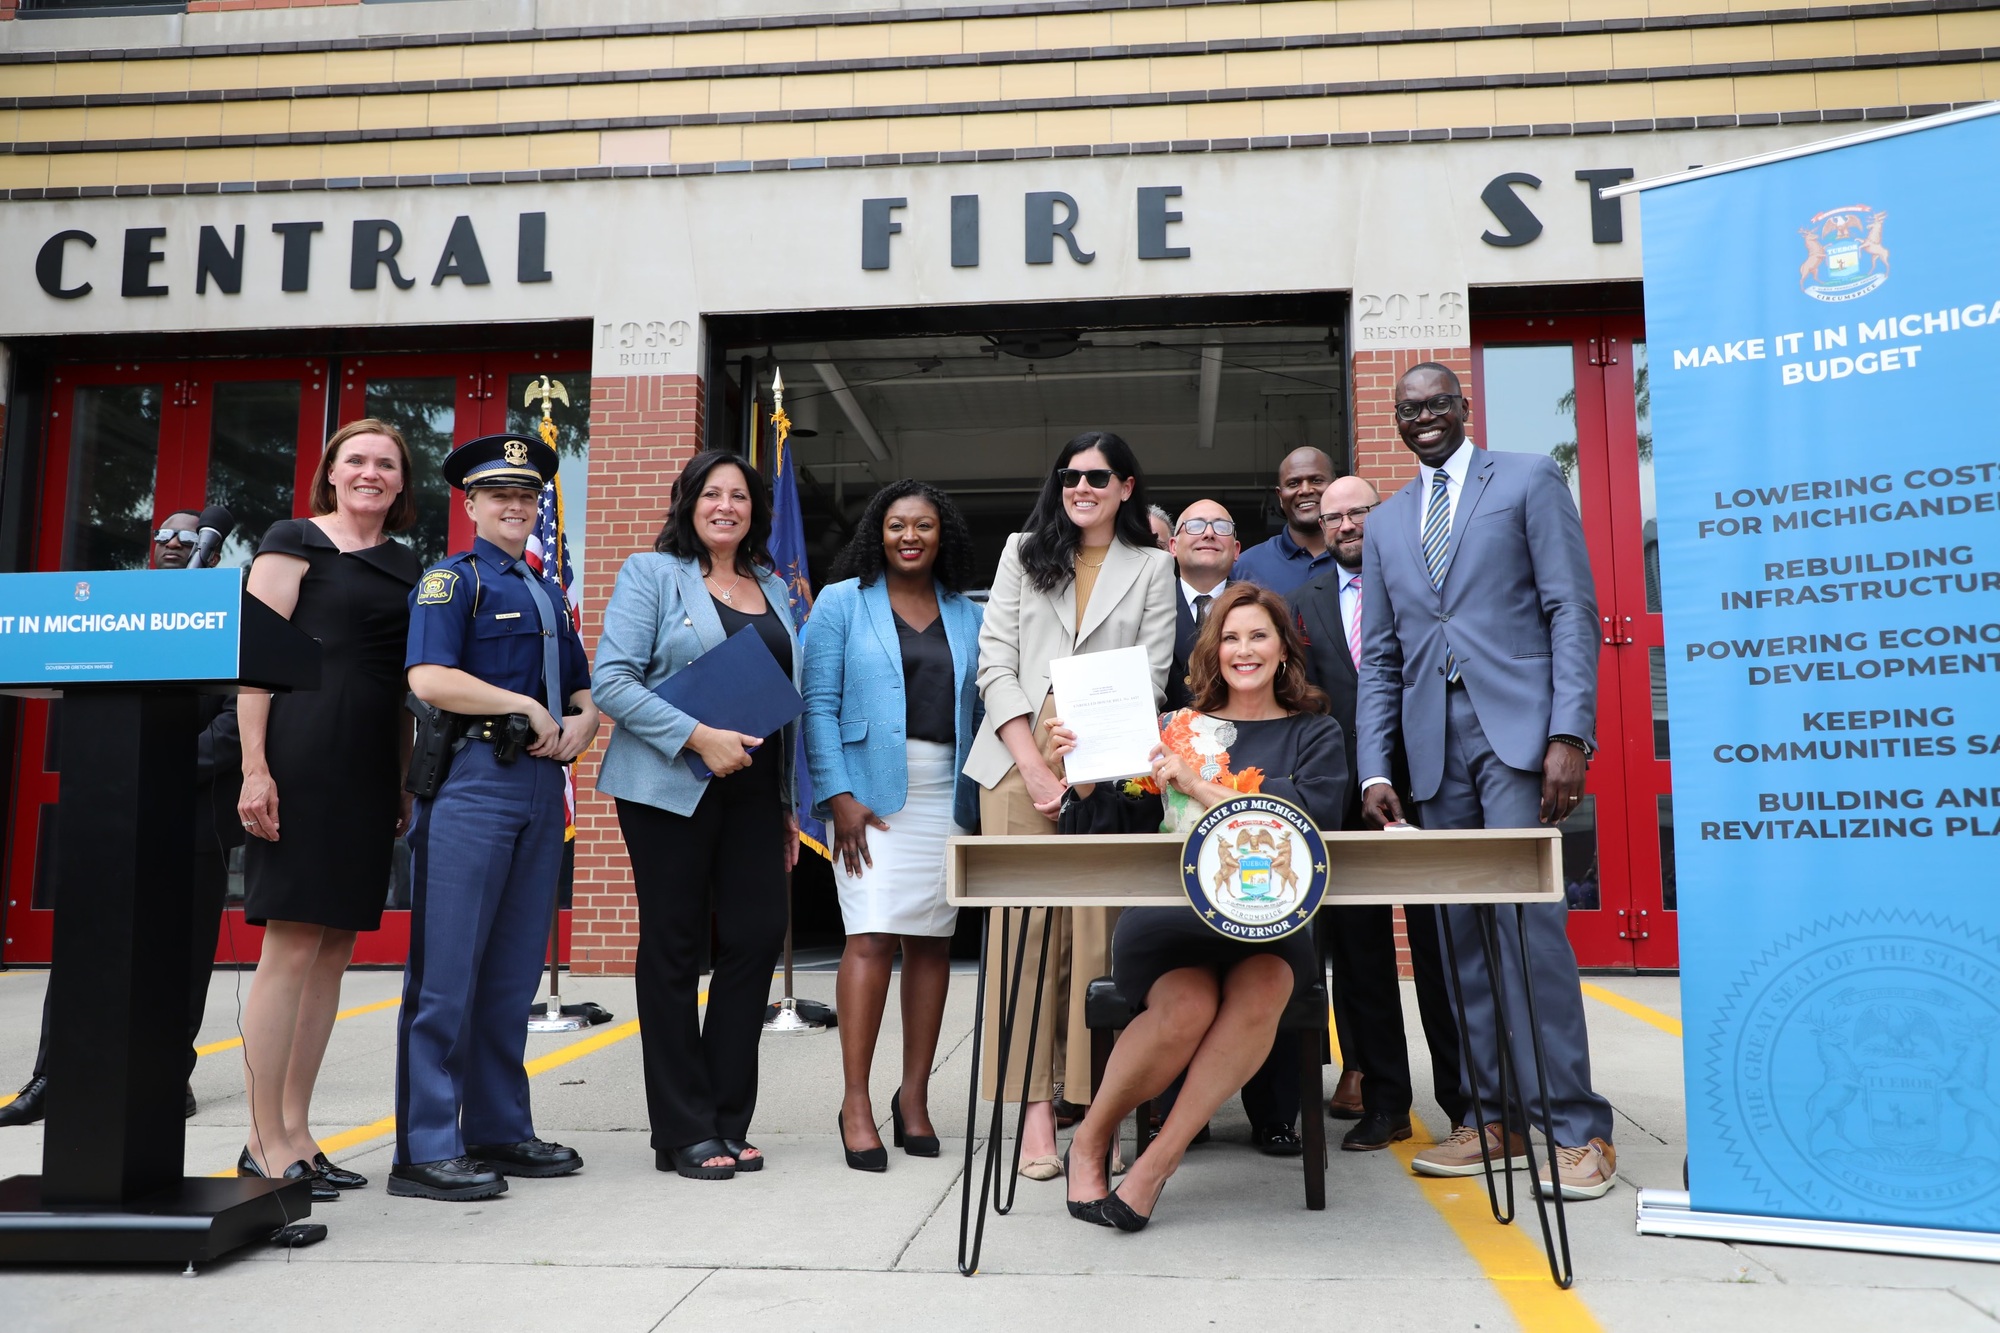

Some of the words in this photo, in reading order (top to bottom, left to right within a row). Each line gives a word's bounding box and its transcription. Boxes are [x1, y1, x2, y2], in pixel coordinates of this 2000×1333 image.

[35, 211, 552, 299] CENTRAL
[862, 186, 1190, 269] FIRE
[1480, 165, 1703, 247] ST
[1359, 292, 1463, 321] 2018
[1816, 283, 1876, 301] CIRCUMSPICE
[599, 321, 691, 349] 1939
[1363, 324, 1461, 339] RESTORED
[619, 352, 671, 366] BUILT
[1673, 337, 1765, 370] MAKE
[1776, 331, 1804, 355] IT
[1814, 327, 1847, 350] IN
[1782, 345, 1922, 386] BUDGET
[1715, 474, 1892, 510] LOWERING
[1903, 463, 2000, 491] COST
[1698, 517, 1762, 539] FOR
[1773, 491, 2000, 532] MICHIGANDE
[1764, 545, 1973, 581] REBUILDING
[1721, 571, 2000, 610] INFRASTRUCTUR
[19, 615, 40, 634] IN
[44, 613, 145, 633] MICHIGAN
[150, 611, 227, 630] BUDGET
[1686, 632, 1866, 661] POWERING
[1879, 623, 2000, 649] ECONO
[1748, 653, 2000, 686] DEVELOPMENT
[1803, 706, 1954, 731] KEEPING
[1713, 735, 1956, 763] COMMUNITIES
[1758, 788, 1924, 812] BUILDING
[1198, 807, 1230, 835] STATE
[1231, 800, 1248, 812] OF
[1251, 799, 1311, 834] MICHIGAN
[1701, 817, 1933, 840] REVITALIZING
[1221, 920, 1291, 937] GOVERNOR
[1230, 908, 1283, 920] CIRCUMSPICE
[1825, 949, 1856, 971] OF
[1861, 944, 1914, 963] THE
[1922, 948, 2000, 995] STATE
[1778, 966, 1823, 1009] SEAL
[1744, 1007, 1777, 1081] GREAT
[1868, 1075, 1933, 1089] TUEBOR
[1746, 1087, 1773, 1136] THE
[1841, 1169, 1980, 1199] CIRCUMSPICE
